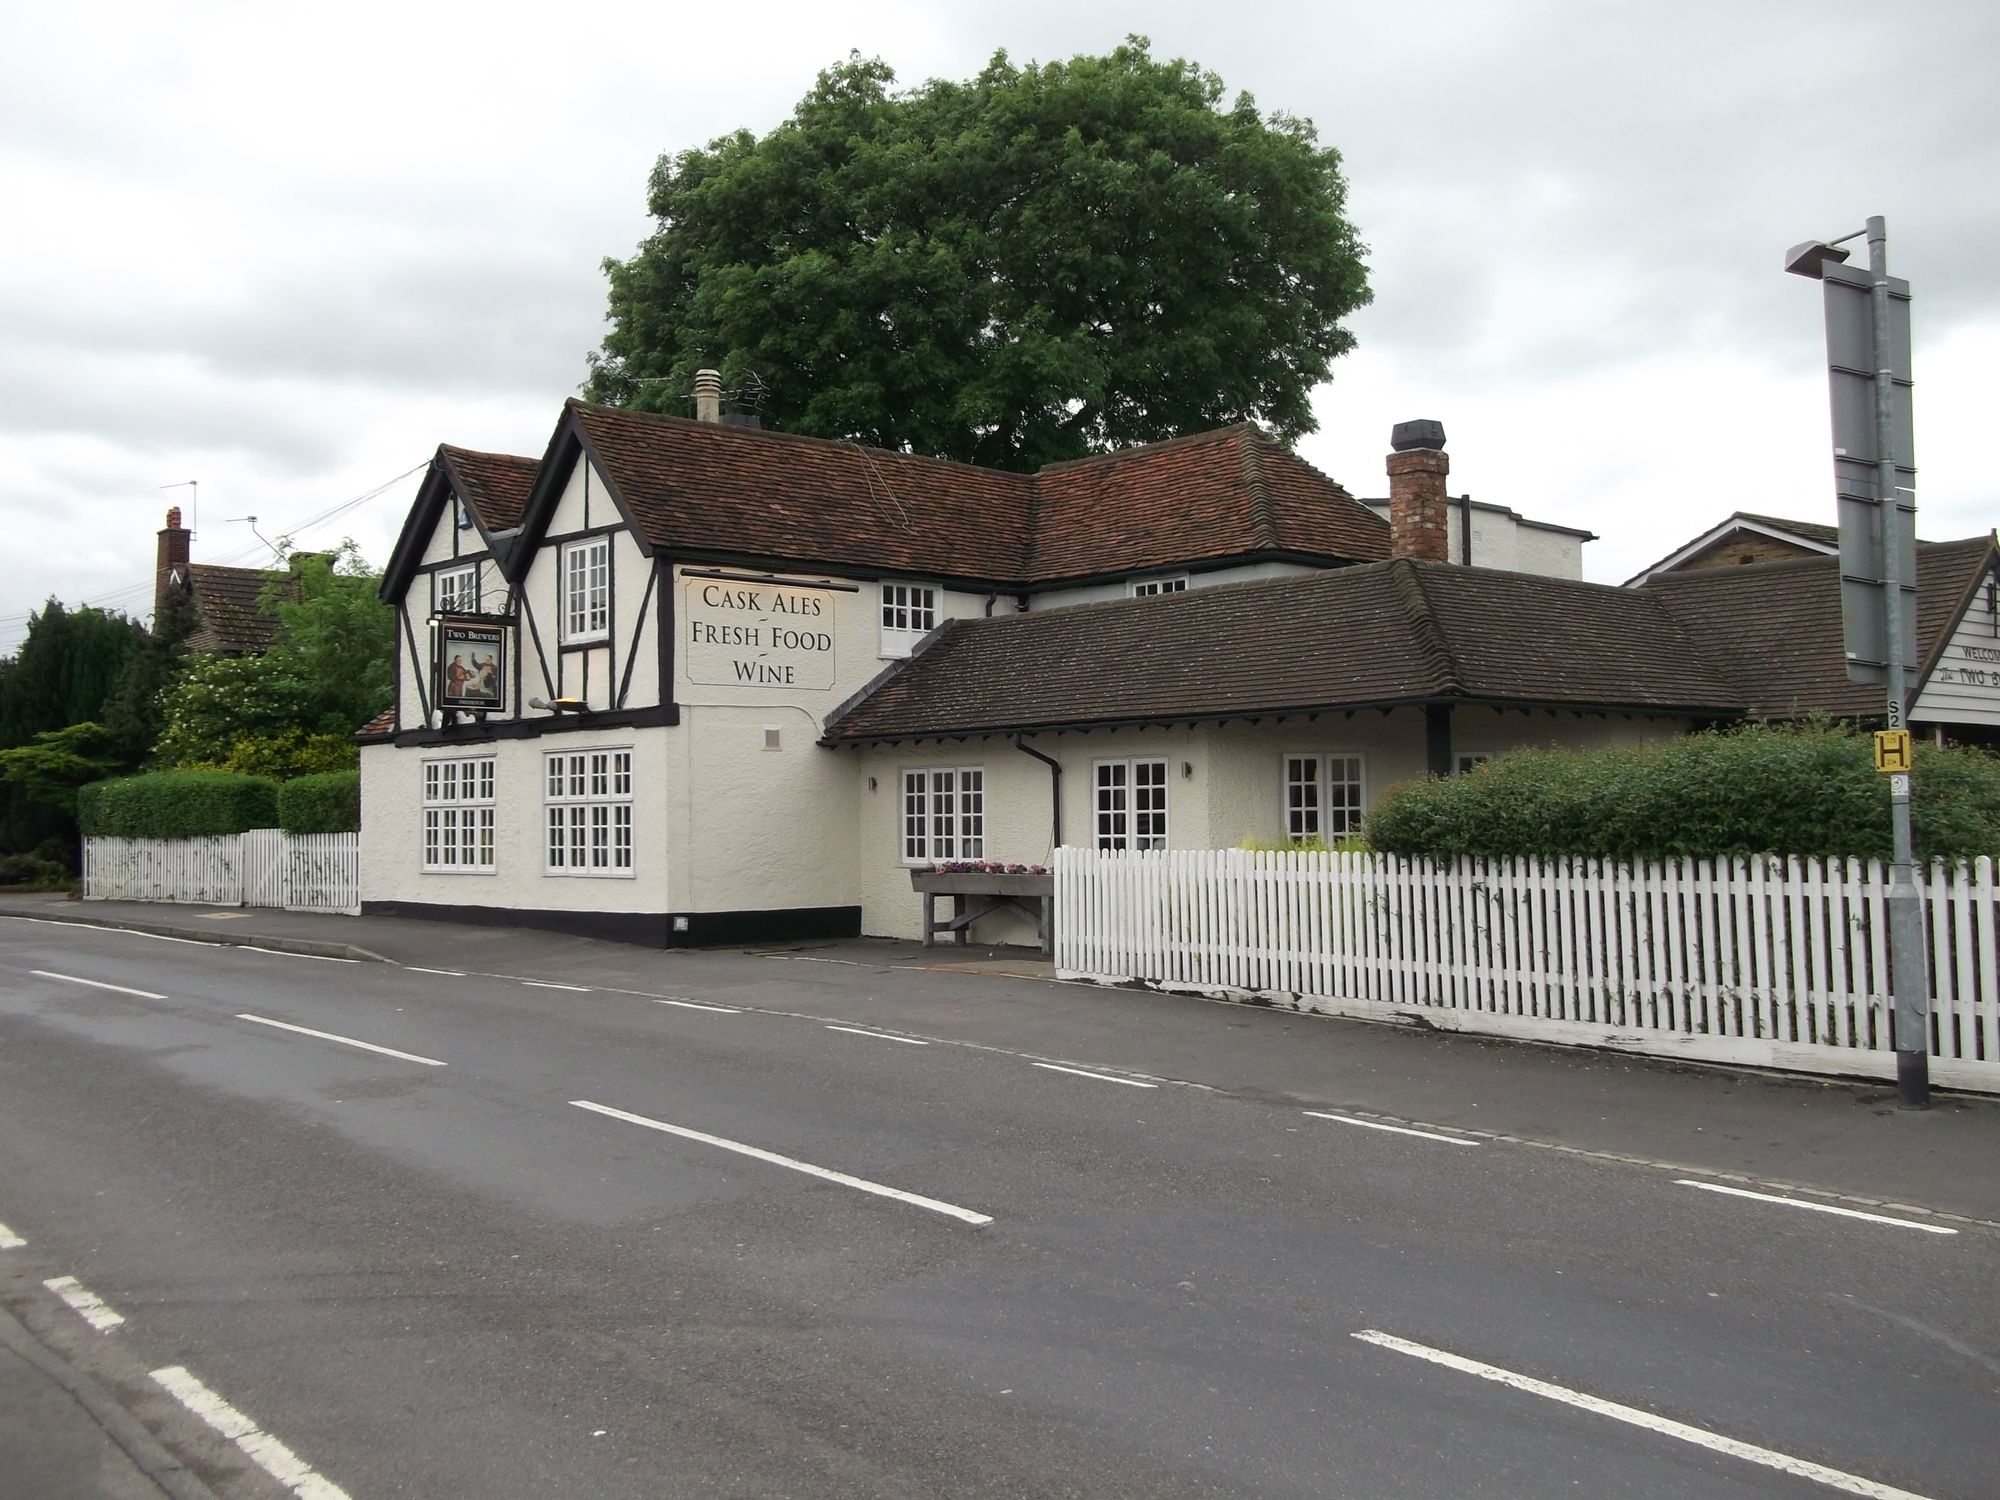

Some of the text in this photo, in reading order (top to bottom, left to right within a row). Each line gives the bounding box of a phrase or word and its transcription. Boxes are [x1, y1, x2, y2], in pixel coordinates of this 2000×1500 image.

[703, 585, 821, 616] CASK ALES
[446, 629, 501, 641] TWO BREWERS
[691, 621, 831, 651] FRESH FOOD
[733, 660, 795, 684] WINE
[1960, 668, 1985, 684] TWO
[1879, 735, 1904, 767] H
